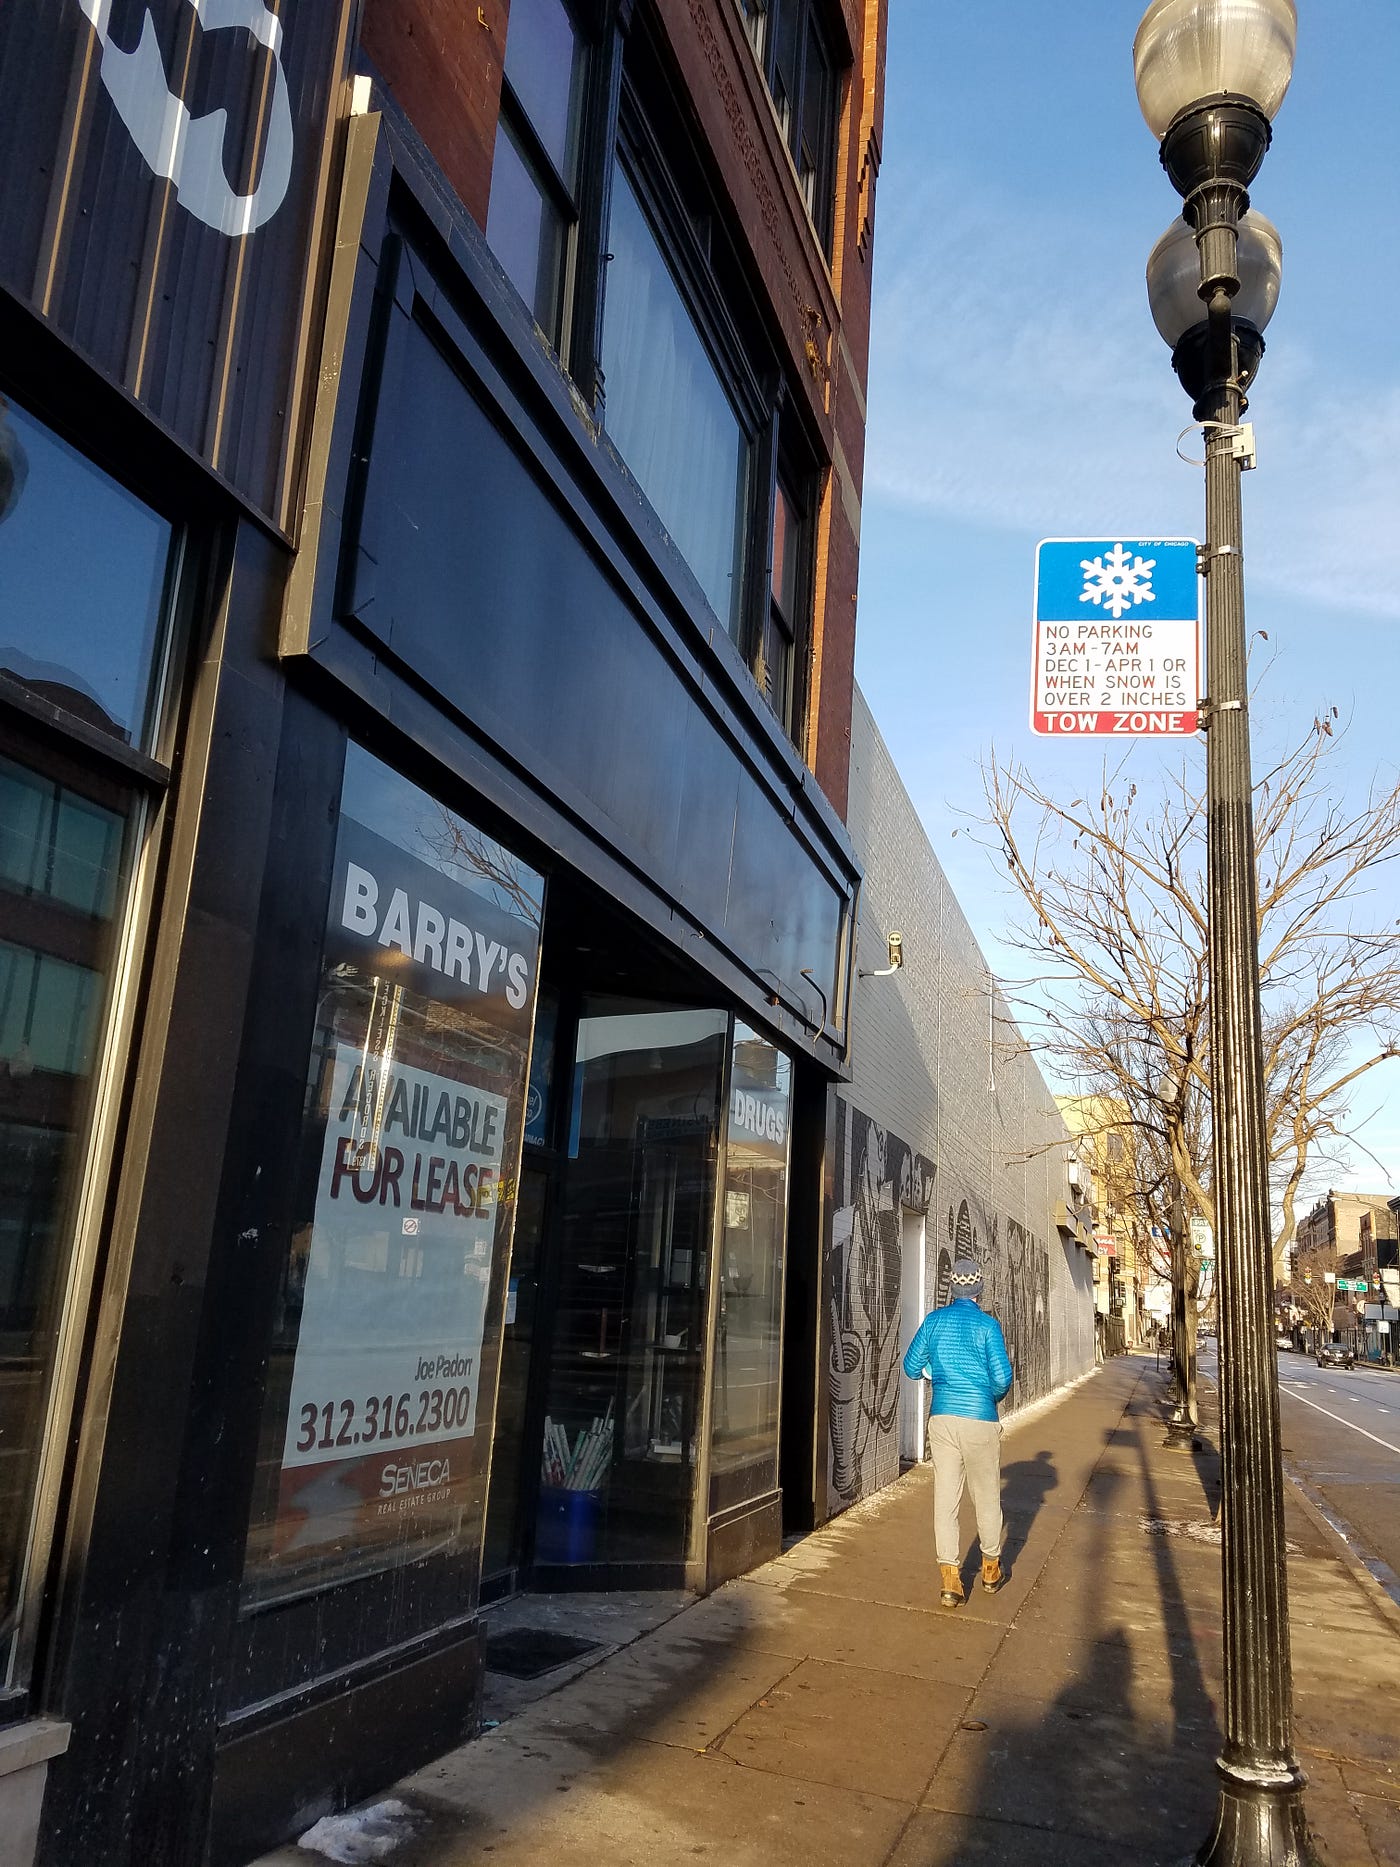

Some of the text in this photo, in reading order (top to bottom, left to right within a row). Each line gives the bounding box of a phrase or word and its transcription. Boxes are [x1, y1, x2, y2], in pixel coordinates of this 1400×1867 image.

[1046, 625, 1153, 639] NO PARKING
[1045, 658, 1078, 672] DEC
[1149, 658, 1154, 672] 1
[1163, 658, 1186, 672] OR
[1045, 675, 1181, 689] WHEN SNOW IS
[1044, 692, 1186, 706] OVER 2 INCHES
[1043, 713, 1185, 732] TOW ZONE
[341, 861, 528, 1010] BARRY'S
[338, 1065, 498, 1156] AVAILABLE
[734, 1088, 785, 1145] DRUGS
[330, 1136, 493, 1220] FOR LEASE
[414, 1356, 435, 1381] Joe
[296, 1386, 471, 1452] 312.316.2300
[379, 1458, 450, 1497] SENECA
[377, 1488, 451, 1516] REAL ESTATE GROUP
